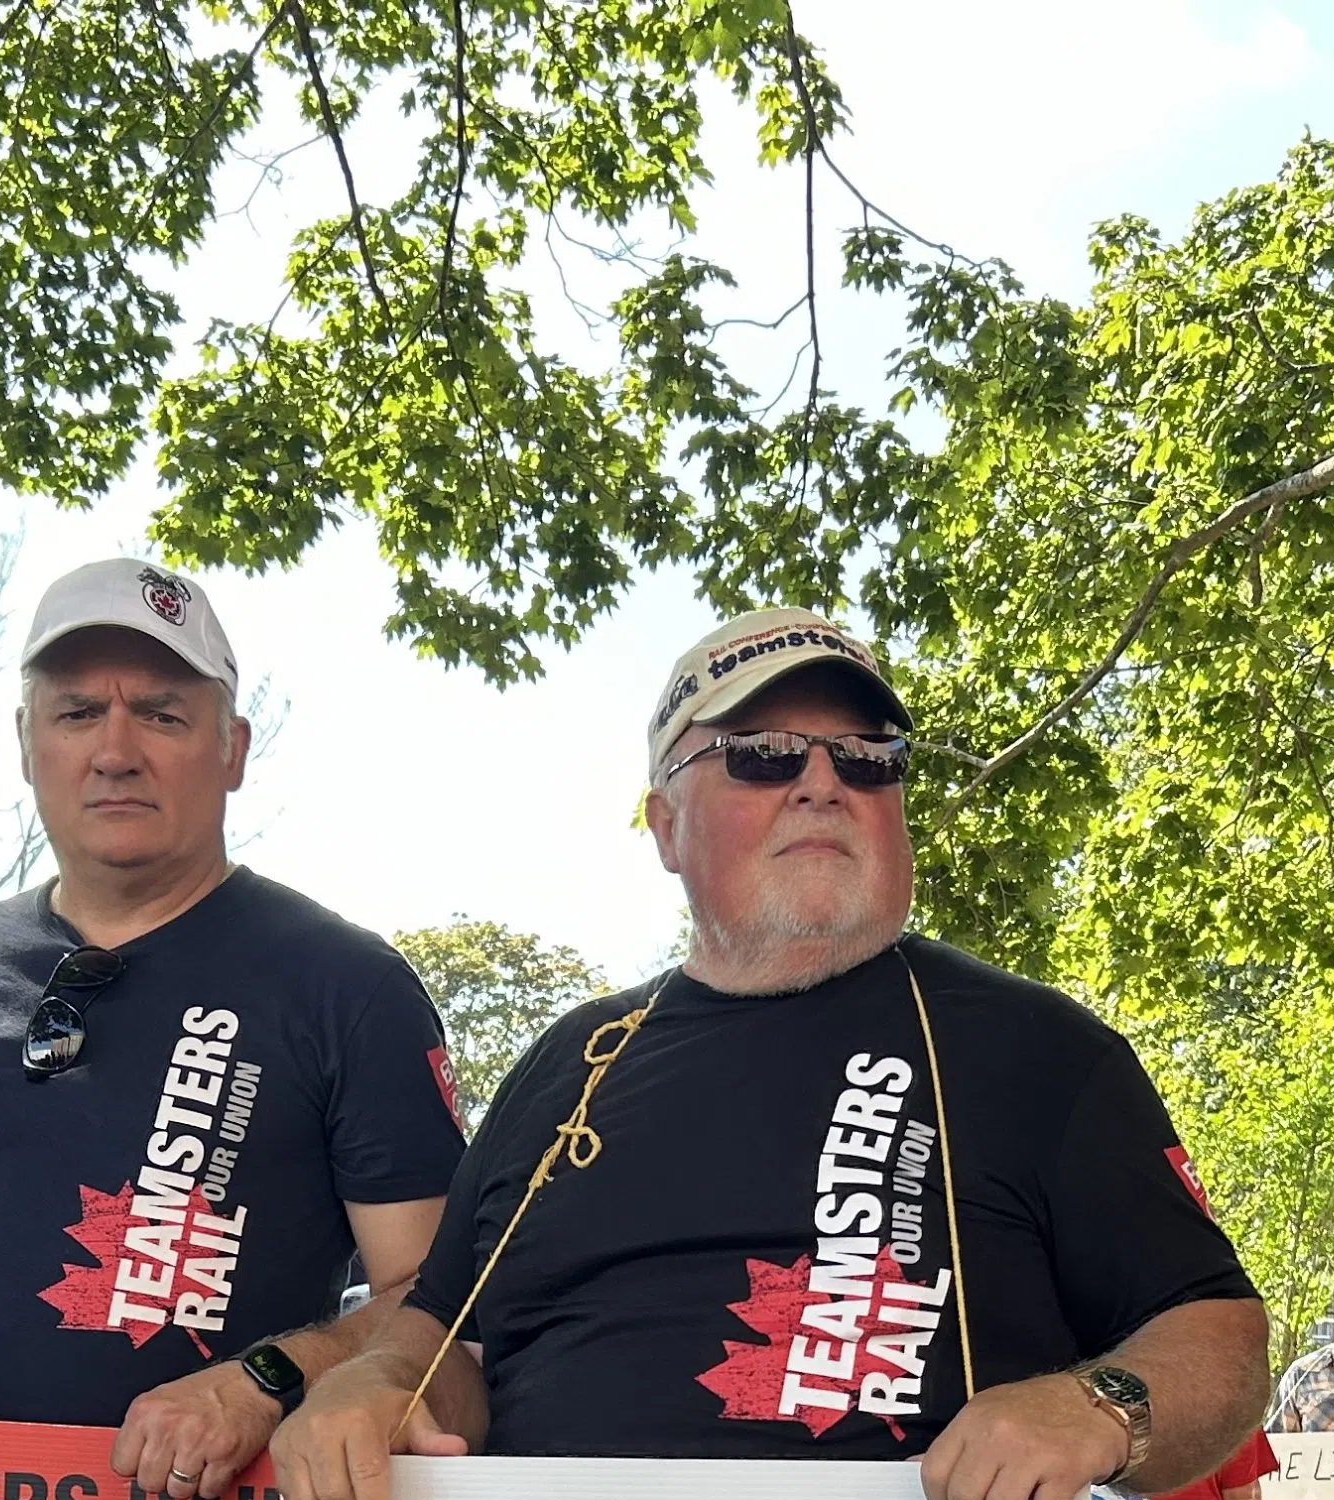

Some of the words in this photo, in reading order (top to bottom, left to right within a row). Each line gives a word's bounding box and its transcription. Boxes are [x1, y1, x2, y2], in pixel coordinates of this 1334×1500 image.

[218, 1060, 263, 1143] UNION
[108, 1005, 241, 1331] TEAMSTERS
[199, 1146, 238, 1203] OUR
[894, 1120, 937, 1197] UNION
[173, 1205, 248, 1333] RAIL
[779, 1051, 914, 1418] TEAMSTERS
[889, 1196, 924, 1265] OUR
[858, 1266, 952, 1417] RAIL
